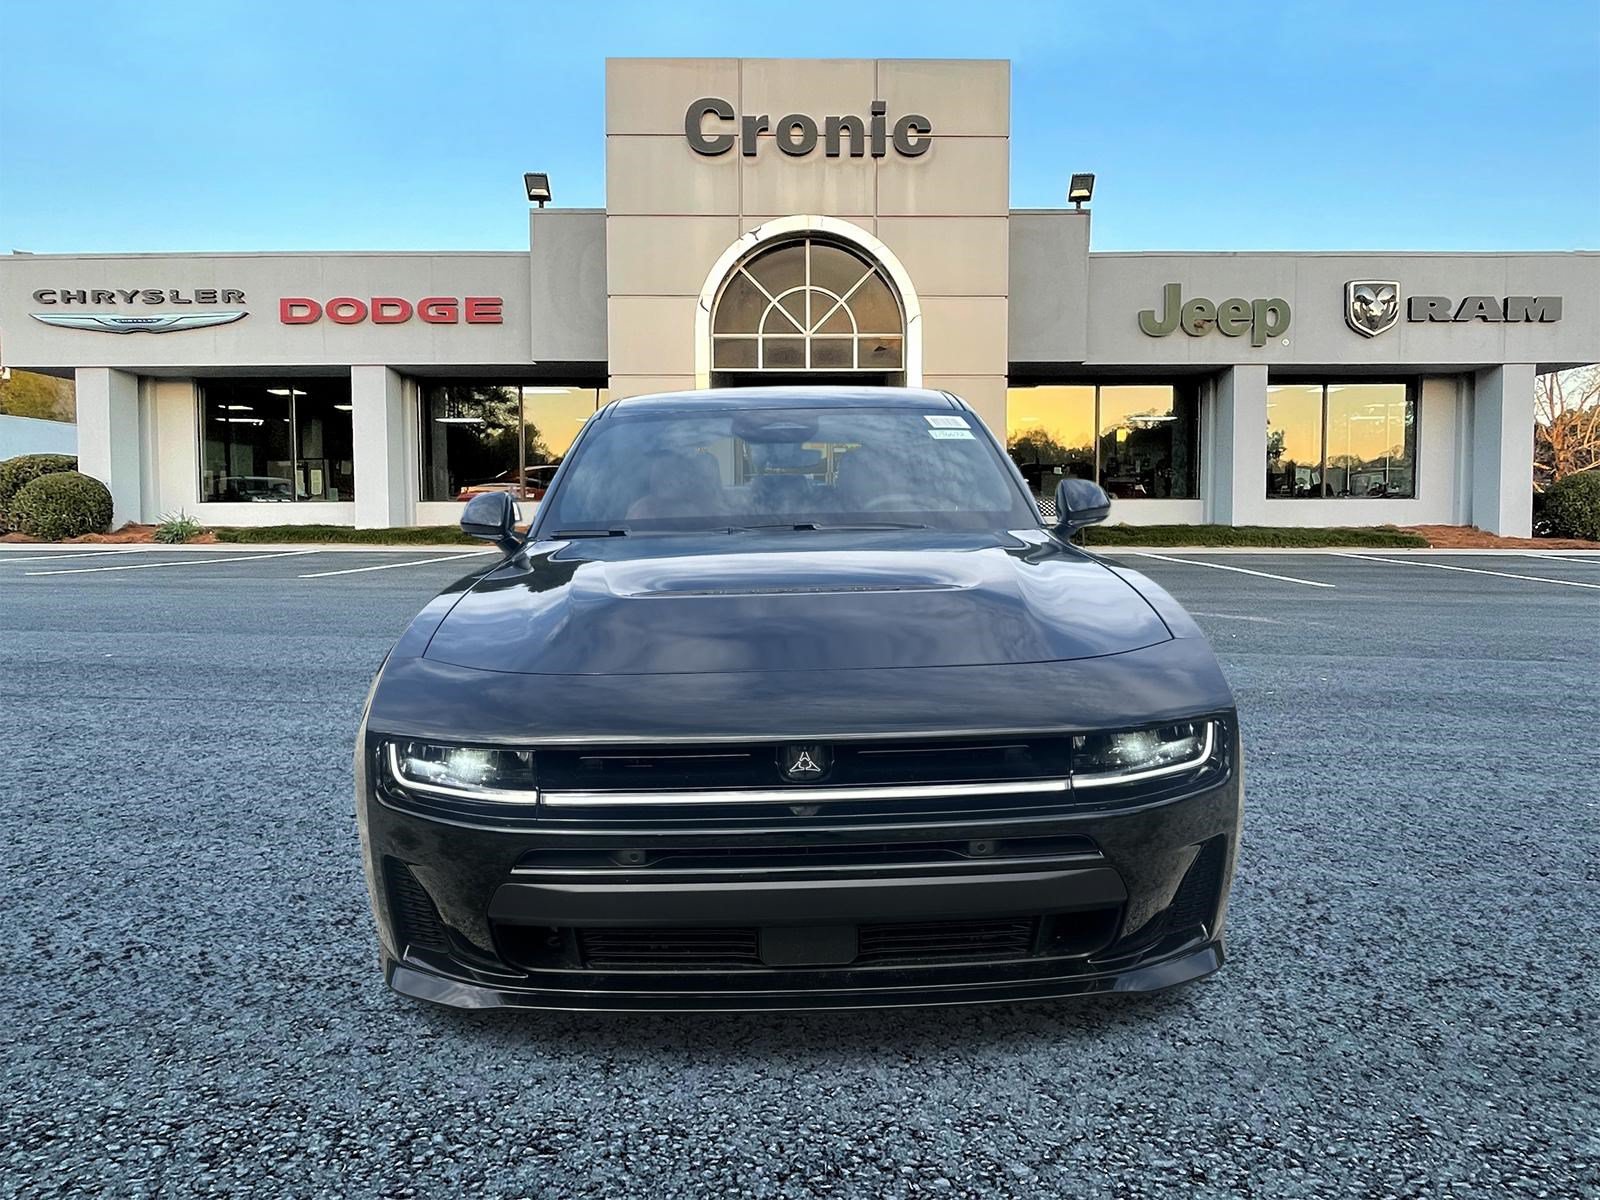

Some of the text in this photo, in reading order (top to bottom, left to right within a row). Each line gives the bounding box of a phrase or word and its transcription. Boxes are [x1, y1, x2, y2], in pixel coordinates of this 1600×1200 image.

[685, 98, 932, 157] Cronic
[33, 288, 246, 305] CHRYSLER
[1408, 296, 1562, 323] RAM
[280, 297, 503, 325] DODGE
[1138, 283, 1291, 346] Jeep
